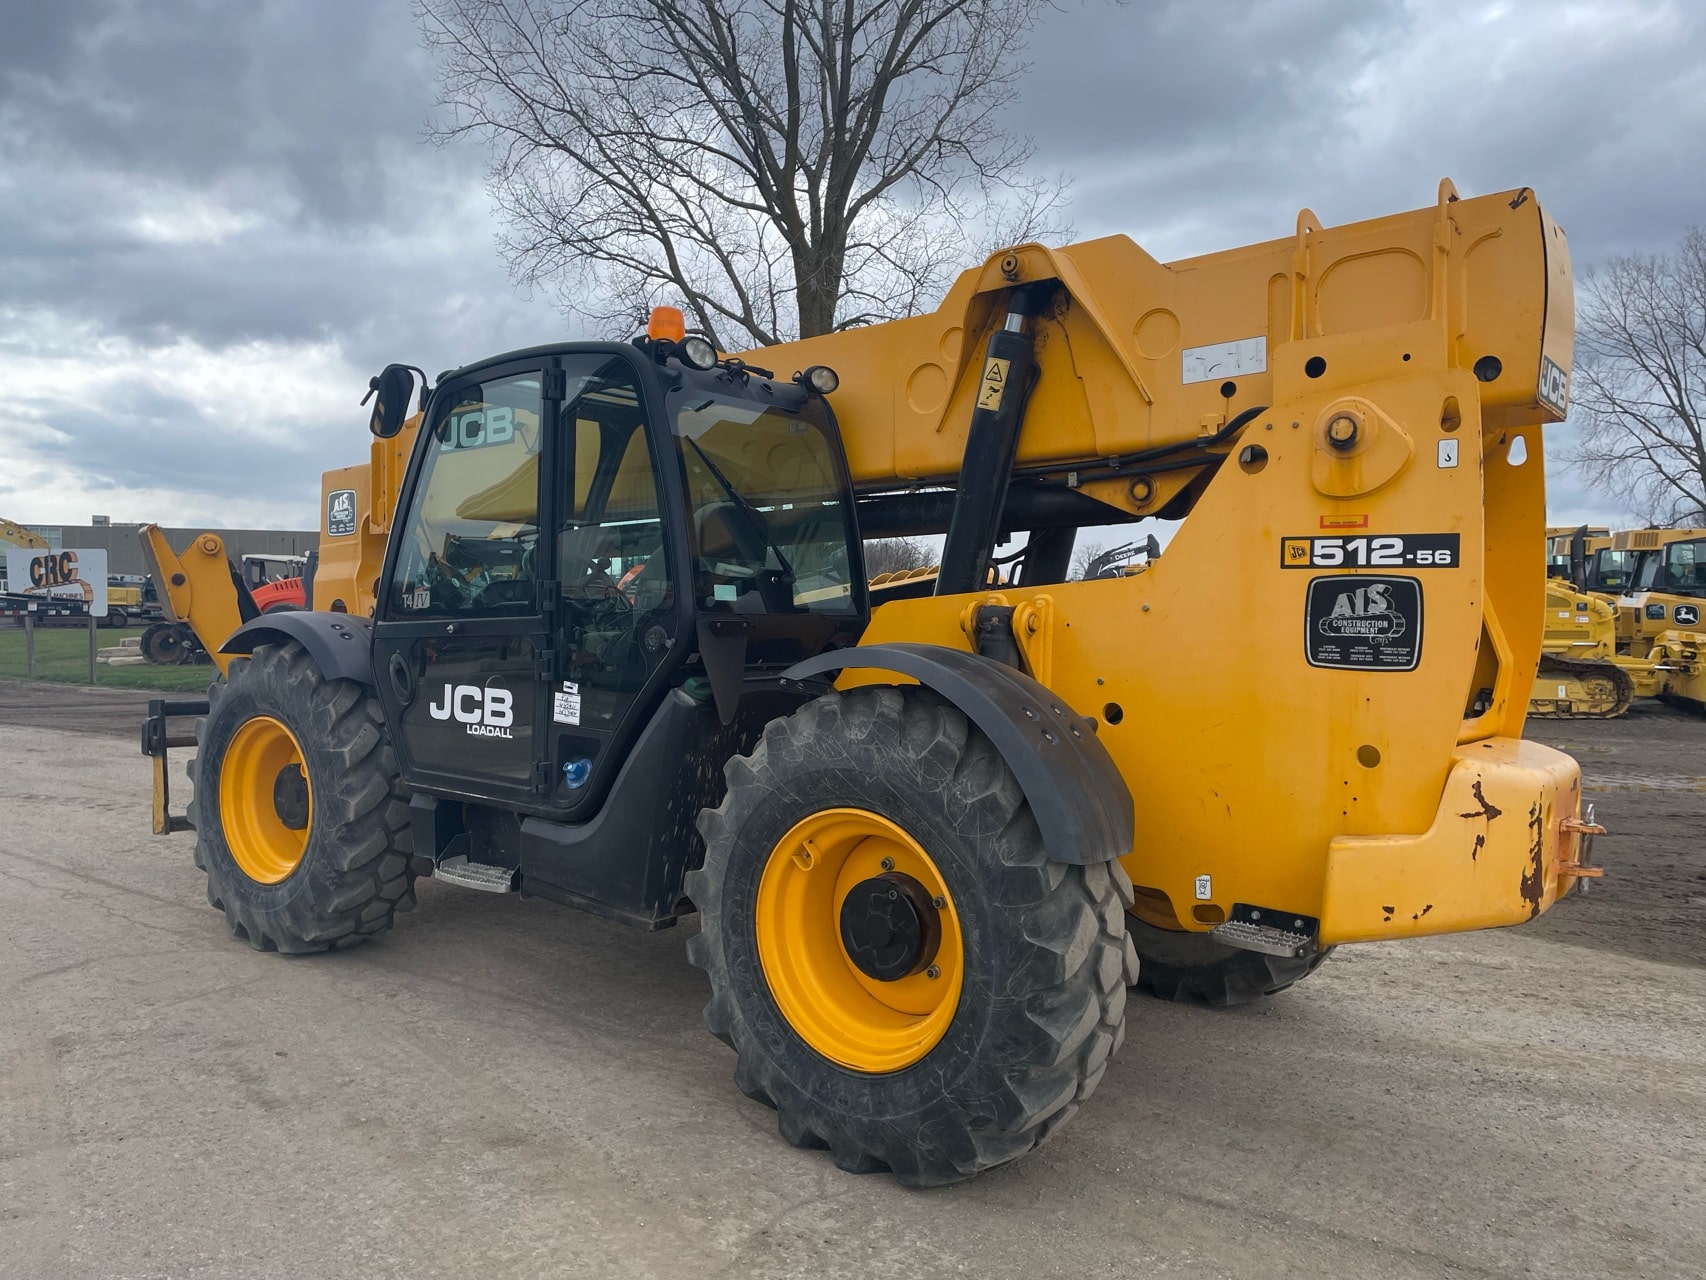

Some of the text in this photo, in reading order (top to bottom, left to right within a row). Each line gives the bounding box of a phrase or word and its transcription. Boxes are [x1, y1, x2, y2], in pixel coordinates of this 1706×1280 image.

[440, 406, 513, 451] JCB
[334, 493, 350, 511] AIS
[1114, 550, 1135, 560] DEERE
[30, 551, 78, 587] CRC
[1331, 583, 1393, 618] AIS
[1332, 619, 1389, 628] CONSTRUCTION
[1341, 626, 1379, 634] EQUIPMENT
[430, 683, 514, 728] JCB
[466, 724, 513, 739] LOADALL
